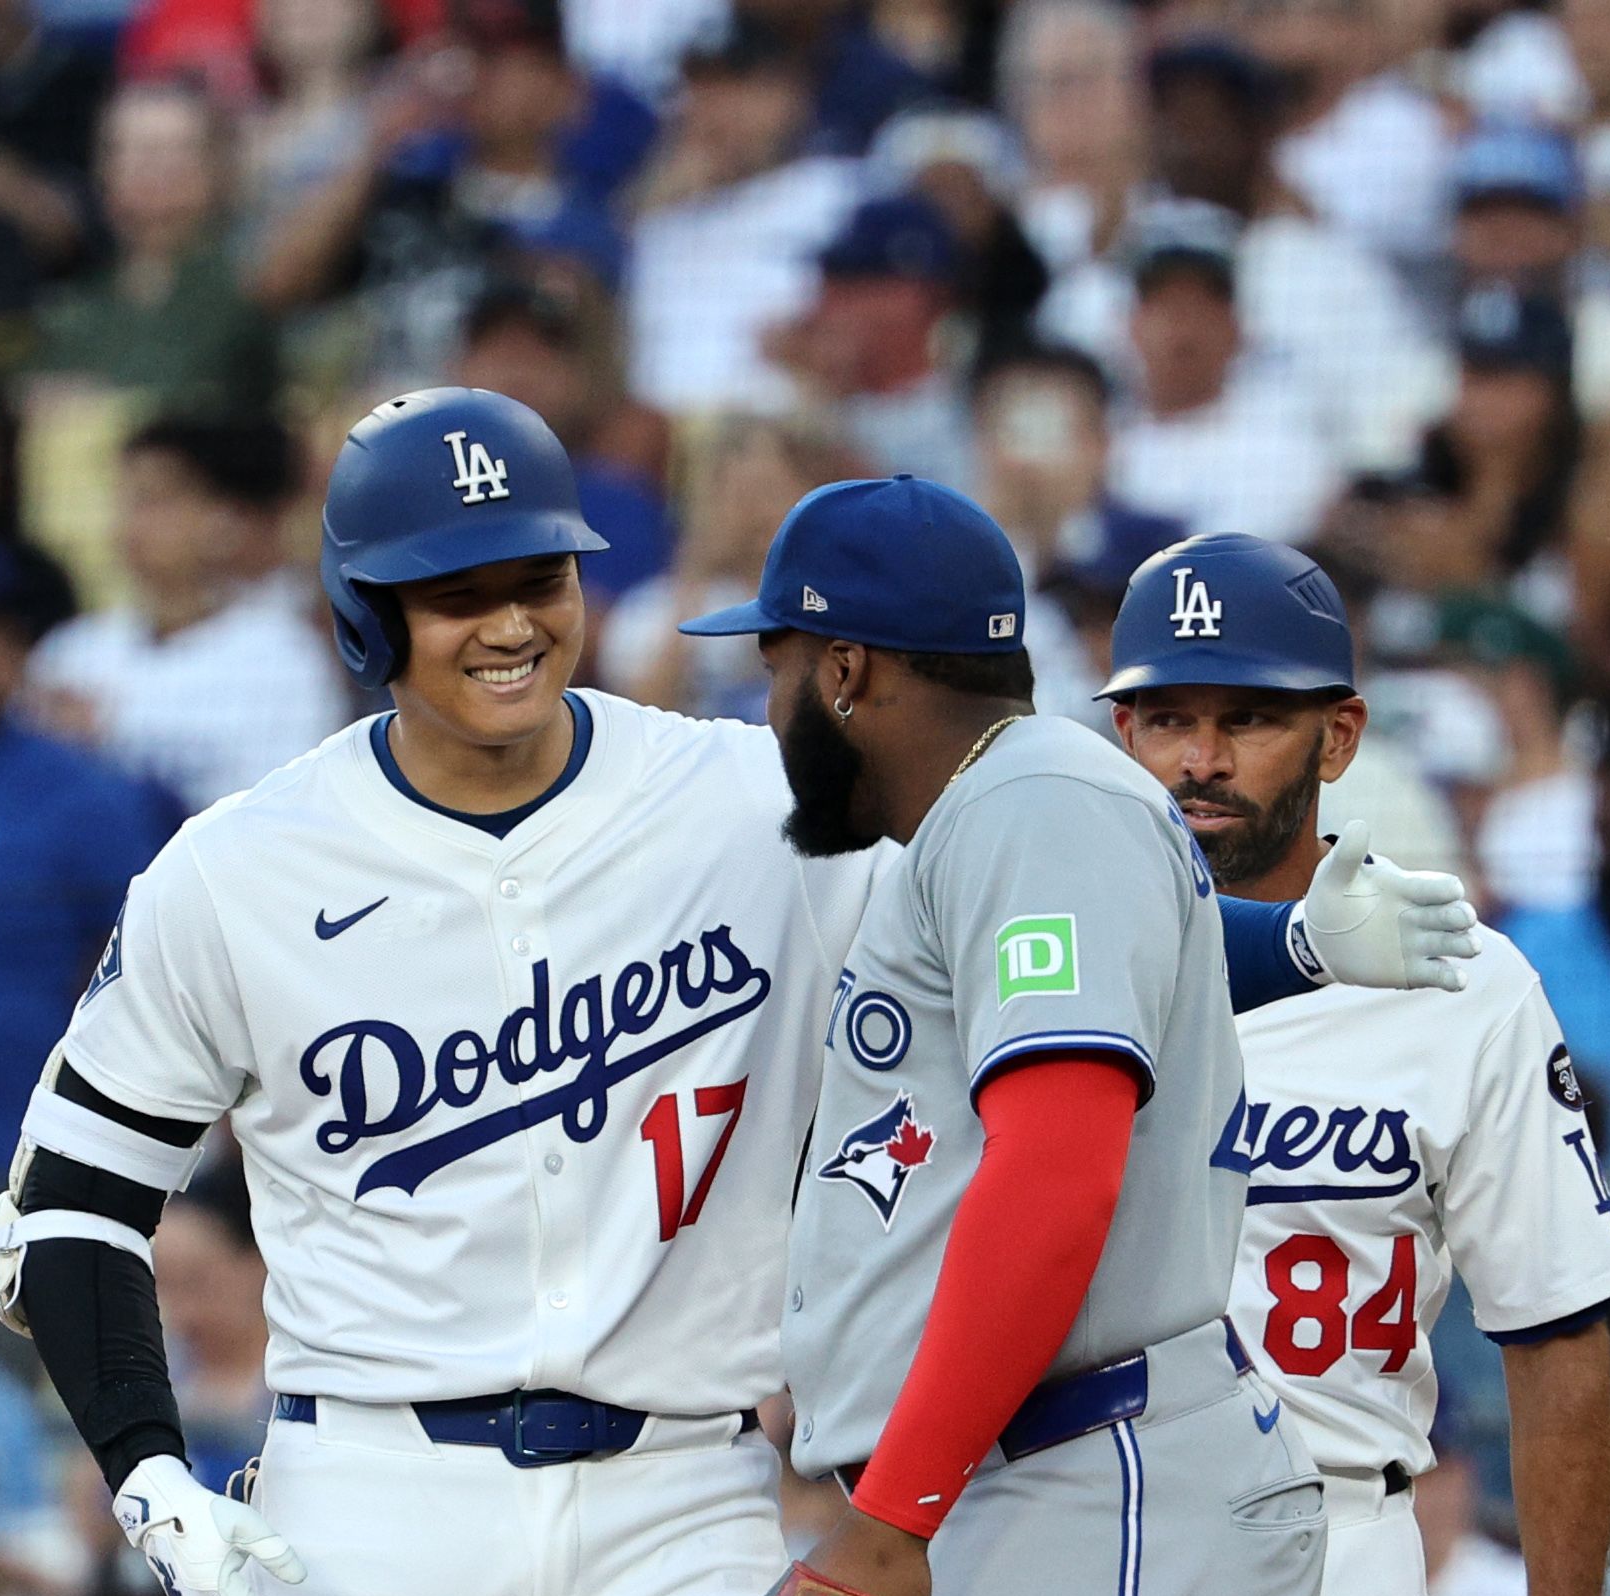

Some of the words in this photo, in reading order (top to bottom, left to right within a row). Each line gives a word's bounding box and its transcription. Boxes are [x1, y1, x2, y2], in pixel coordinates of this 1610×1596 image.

[443, 430, 510, 504] LA
[1170, 567, 1222, 637] LA
[1000, 931, 1064, 982] TD
[300, 924, 771, 1160] Dodgers
[640, 1074, 749, 1242] 17
[1263, 1233, 1417, 1377] 84
